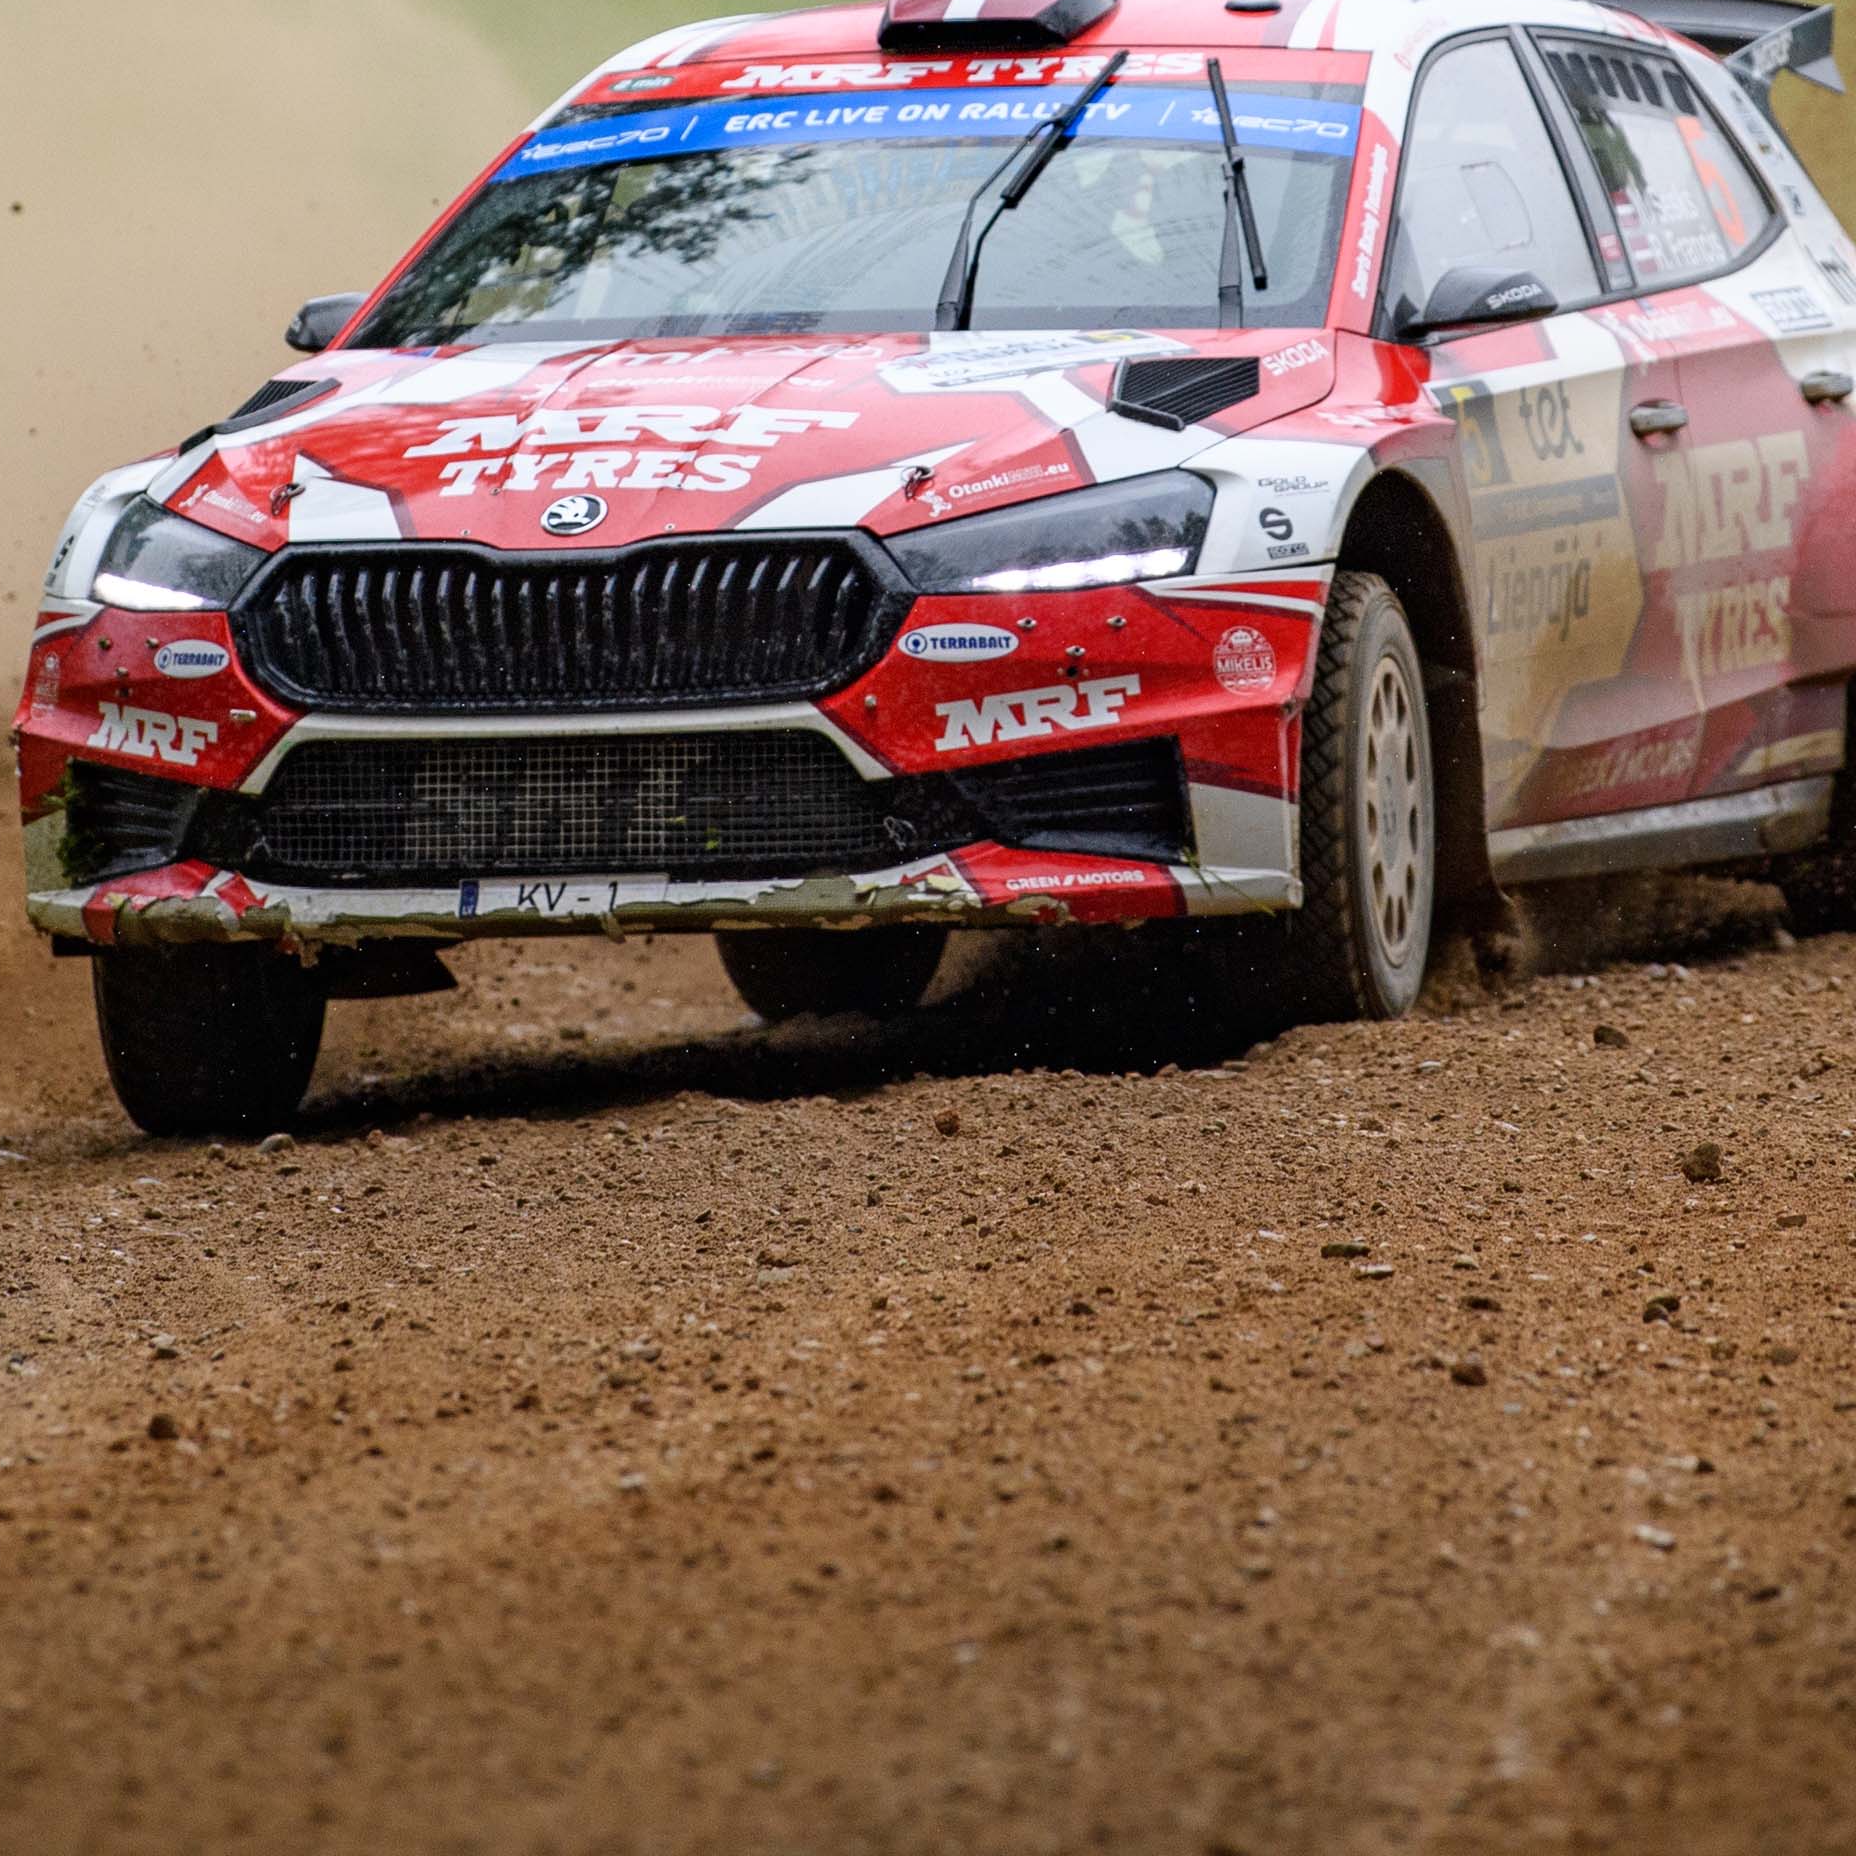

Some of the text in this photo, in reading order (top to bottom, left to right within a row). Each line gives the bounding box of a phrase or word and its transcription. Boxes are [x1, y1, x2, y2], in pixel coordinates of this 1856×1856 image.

[720, 52, 1204, 88] MRF TYRES
[724, 110, 799, 132] ERC
[804, 105, 891, 126] LIVE
[897, 103, 951, 122] ON
[958, 101, 1064, 121] RALL
[402, 404, 861, 459] MRF
[439, 449, 762, 498] TYRES
[1653, 430, 1810, 572] MRF
[930, 636, 1013, 650] TERRABALT
[86, 700, 219, 766] MRF
[934, 673, 1142, 752] MRF
[1006, 870, 1145, 891] GREEN MOTORS
